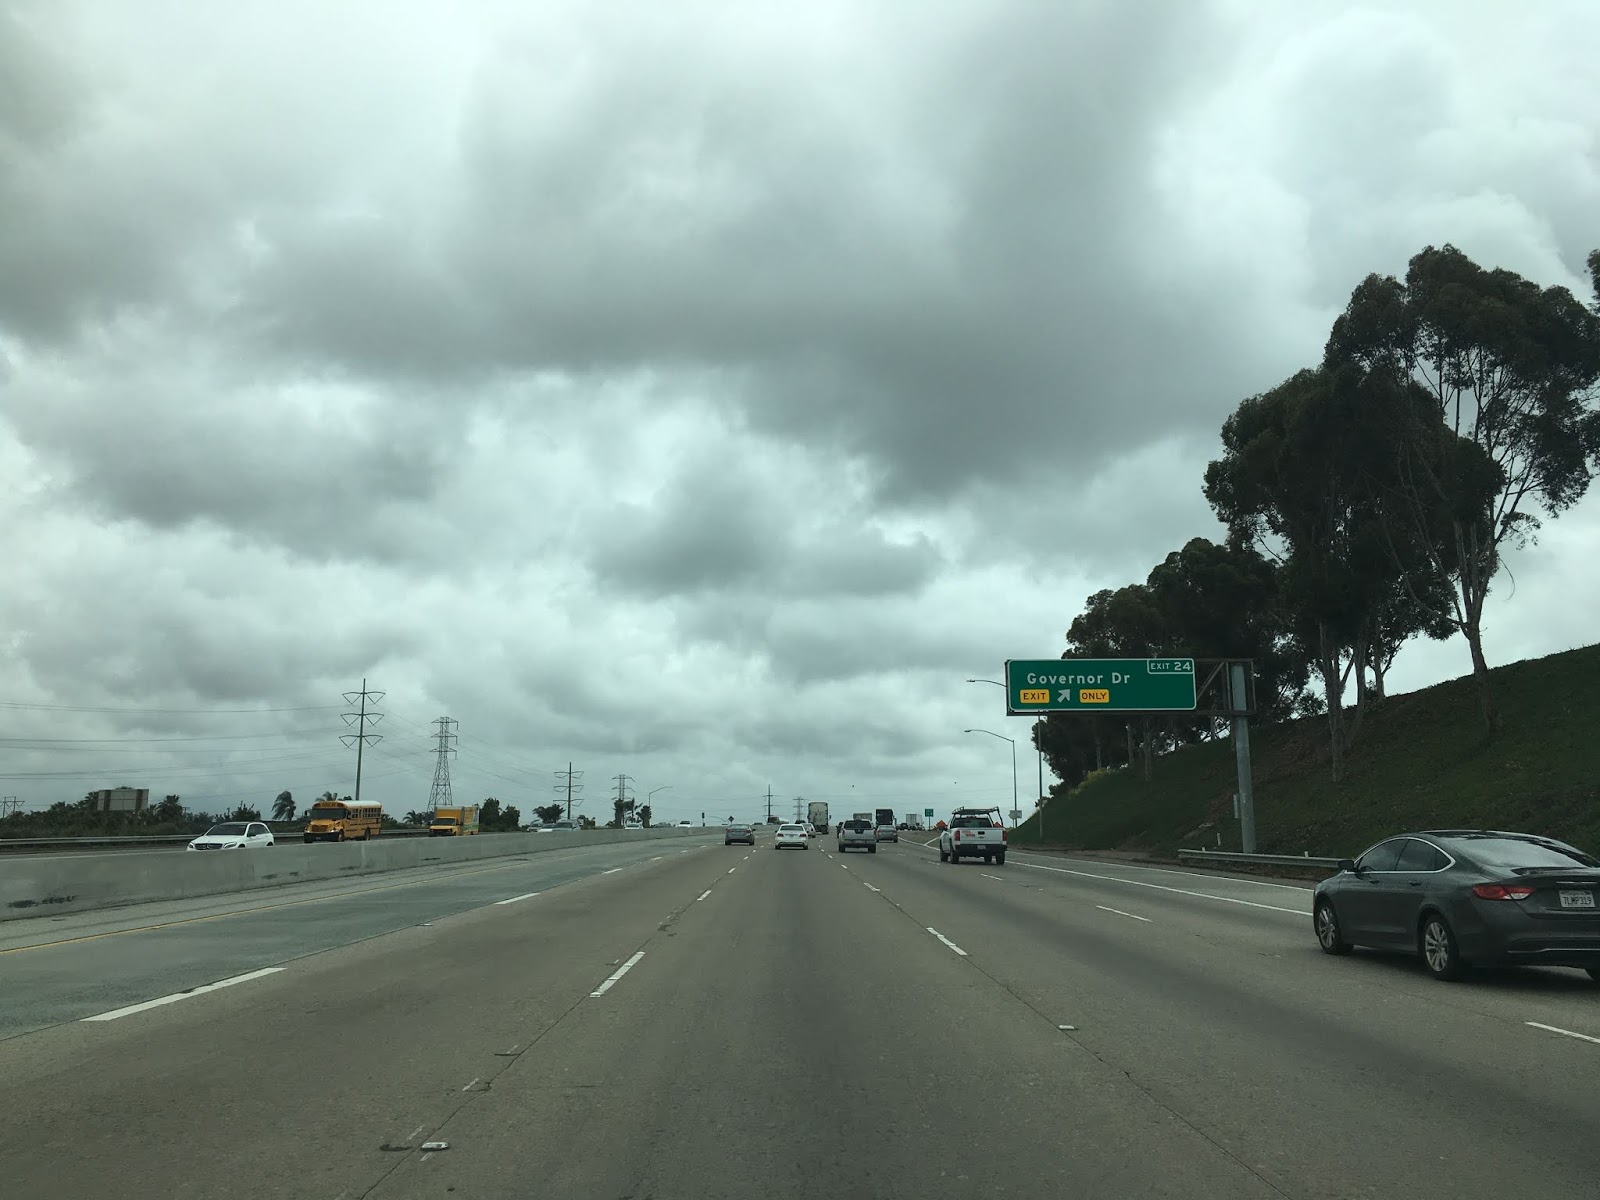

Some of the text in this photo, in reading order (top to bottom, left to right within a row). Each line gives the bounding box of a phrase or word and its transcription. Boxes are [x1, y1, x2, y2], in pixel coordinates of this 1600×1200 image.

[1150, 661, 1191, 671] EXIT 24
[1026, 672, 1131, 685] Governor Dr
[1023, 692, 1047, 701] EXIT
[1081, 692, 1107, 701] ONLY
